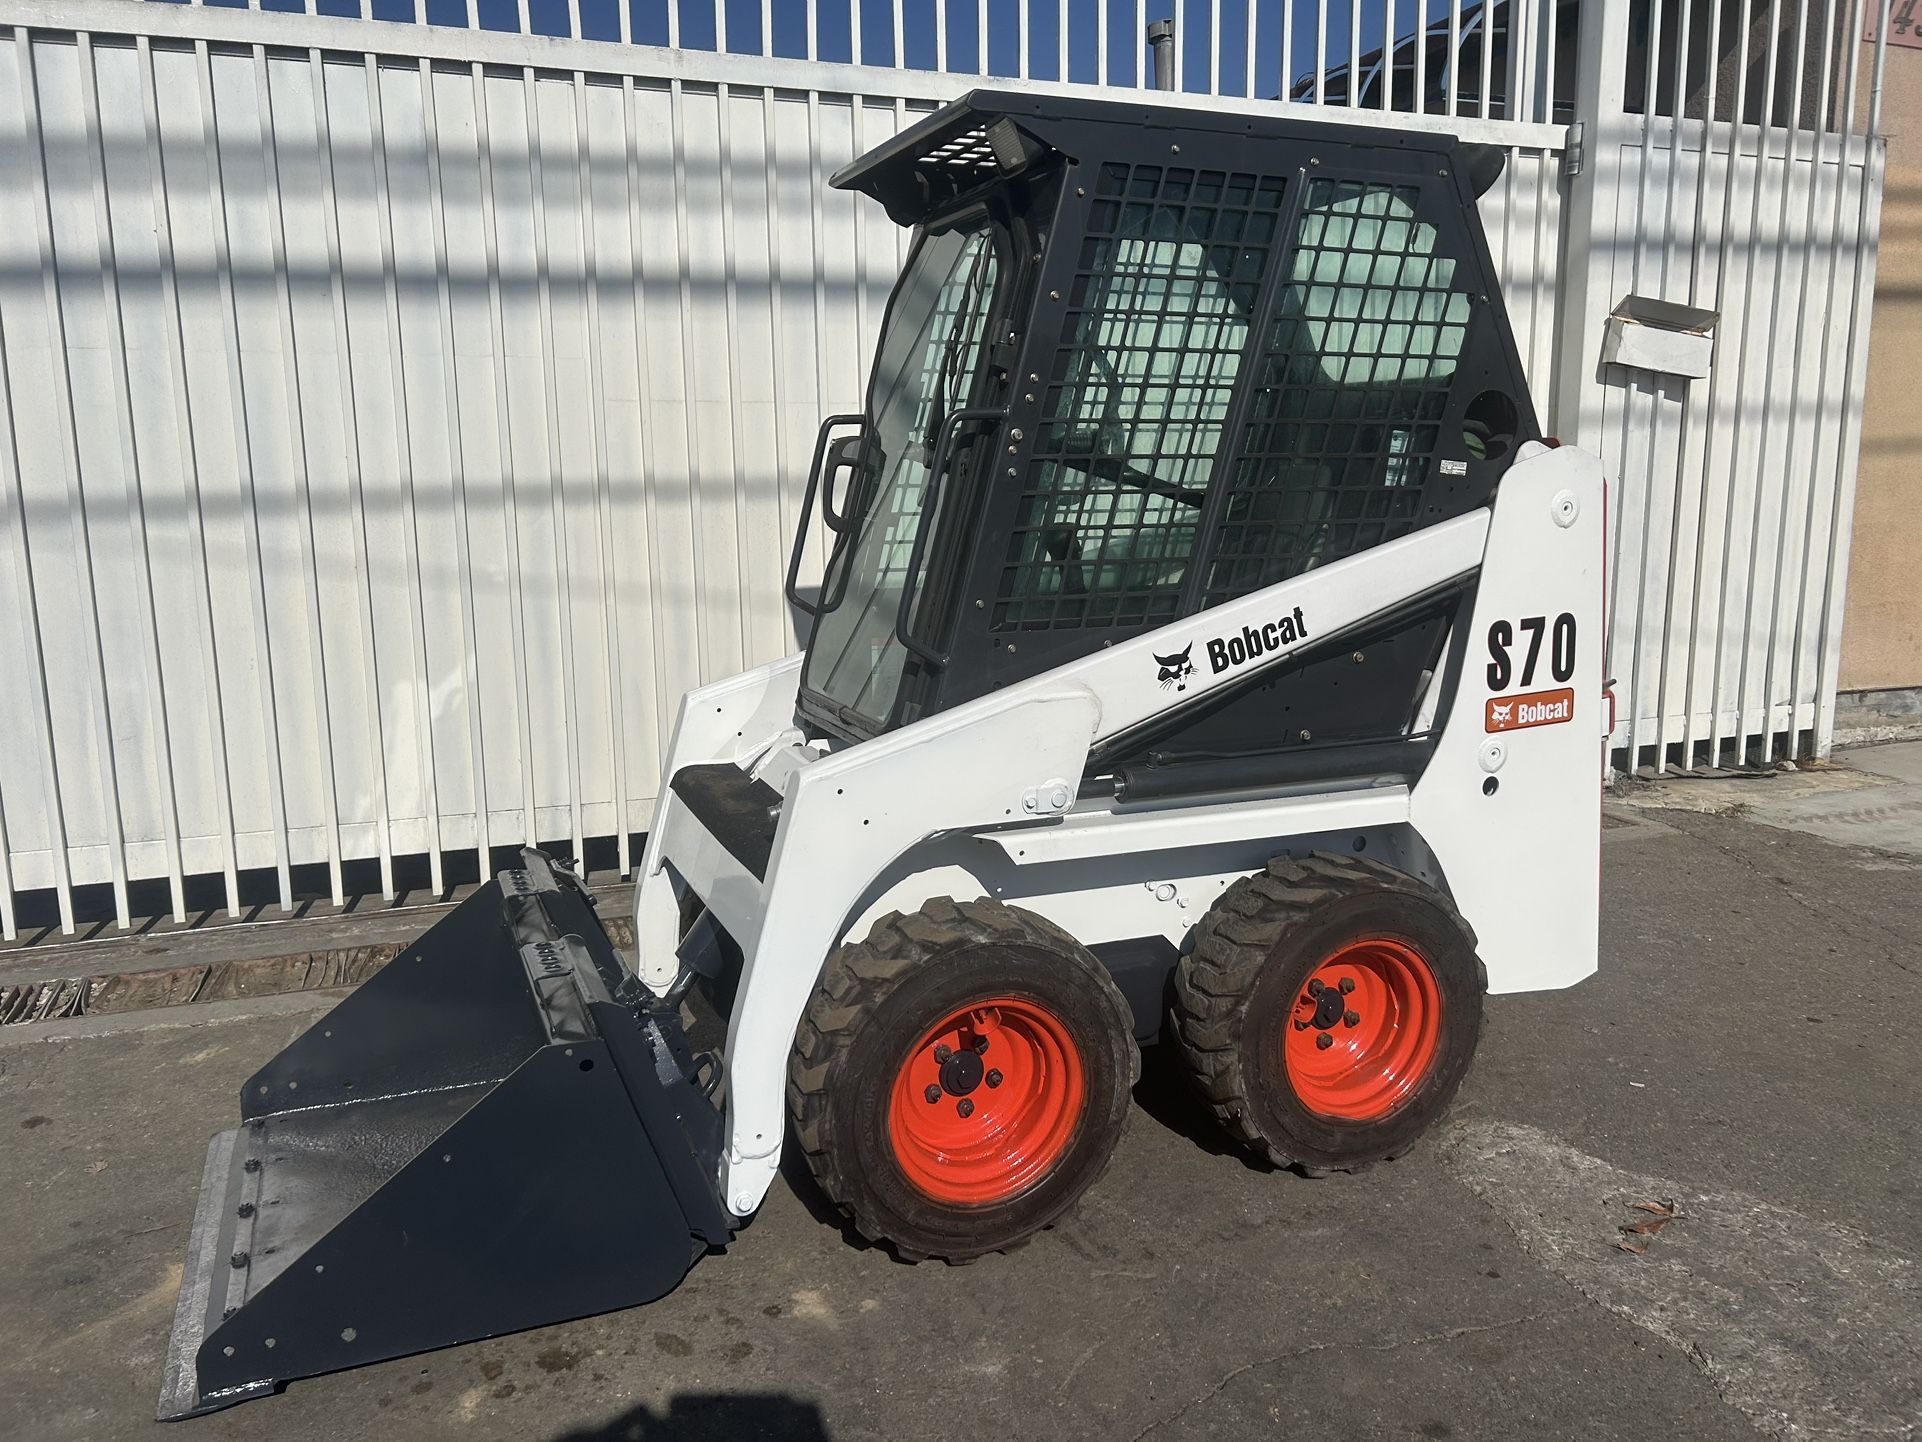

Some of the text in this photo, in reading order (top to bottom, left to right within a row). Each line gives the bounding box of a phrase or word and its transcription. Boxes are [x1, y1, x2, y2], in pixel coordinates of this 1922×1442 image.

[1206, 606, 1308, 675] Bobcat
[1486, 612, 1577, 692] S70
[1518, 699, 1569, 724] Bobcat
